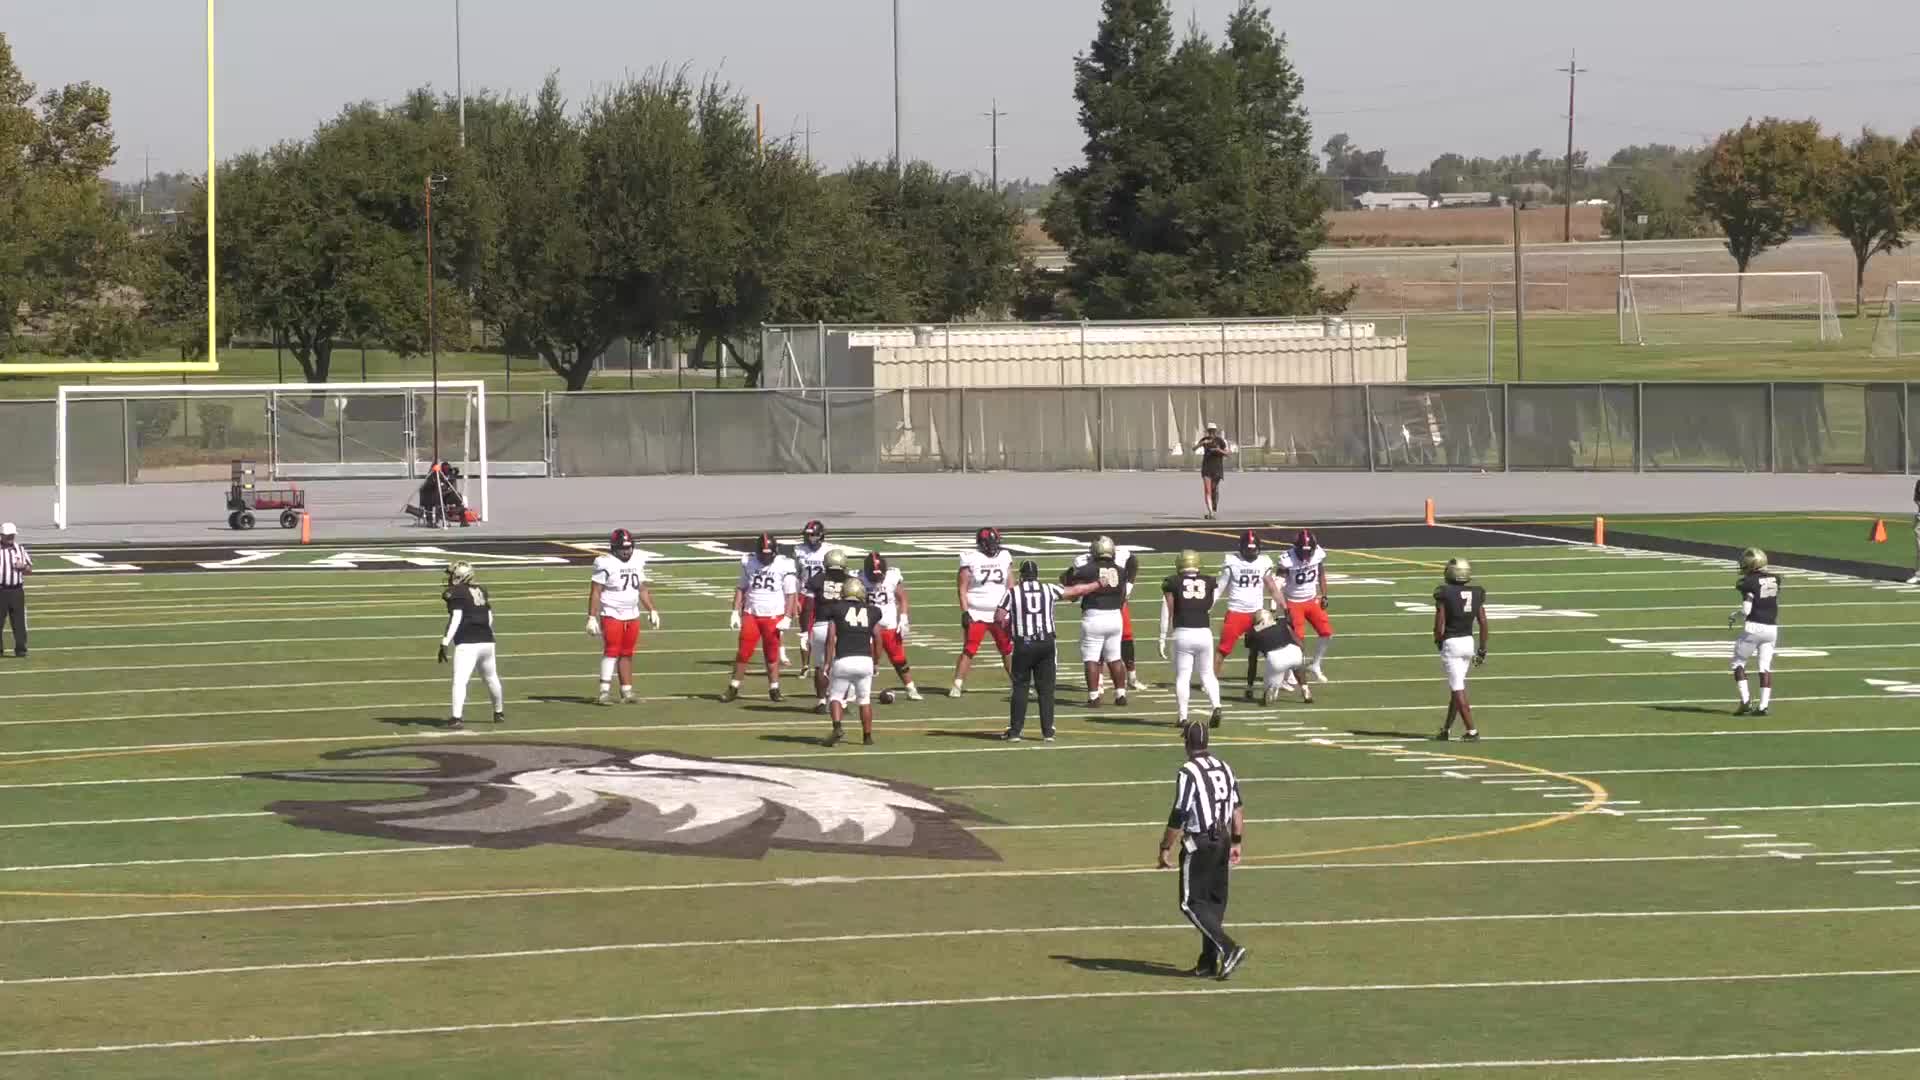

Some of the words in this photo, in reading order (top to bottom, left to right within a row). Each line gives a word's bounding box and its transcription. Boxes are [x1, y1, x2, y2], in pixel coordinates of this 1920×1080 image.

[620, 573, 640, 591] 70
[752, 575, 775, 592] 66
[981, 569, 1004, 585] 73
[1240, 575, 1260, 588] 87
[1182, 578, 1206, 599] 33
[1024, 592, 1041, 613] U
[1461, 591, 1472, 612] 7
[845, 606, 869, 628] 44
[1207, 770, 1229, 800] B
